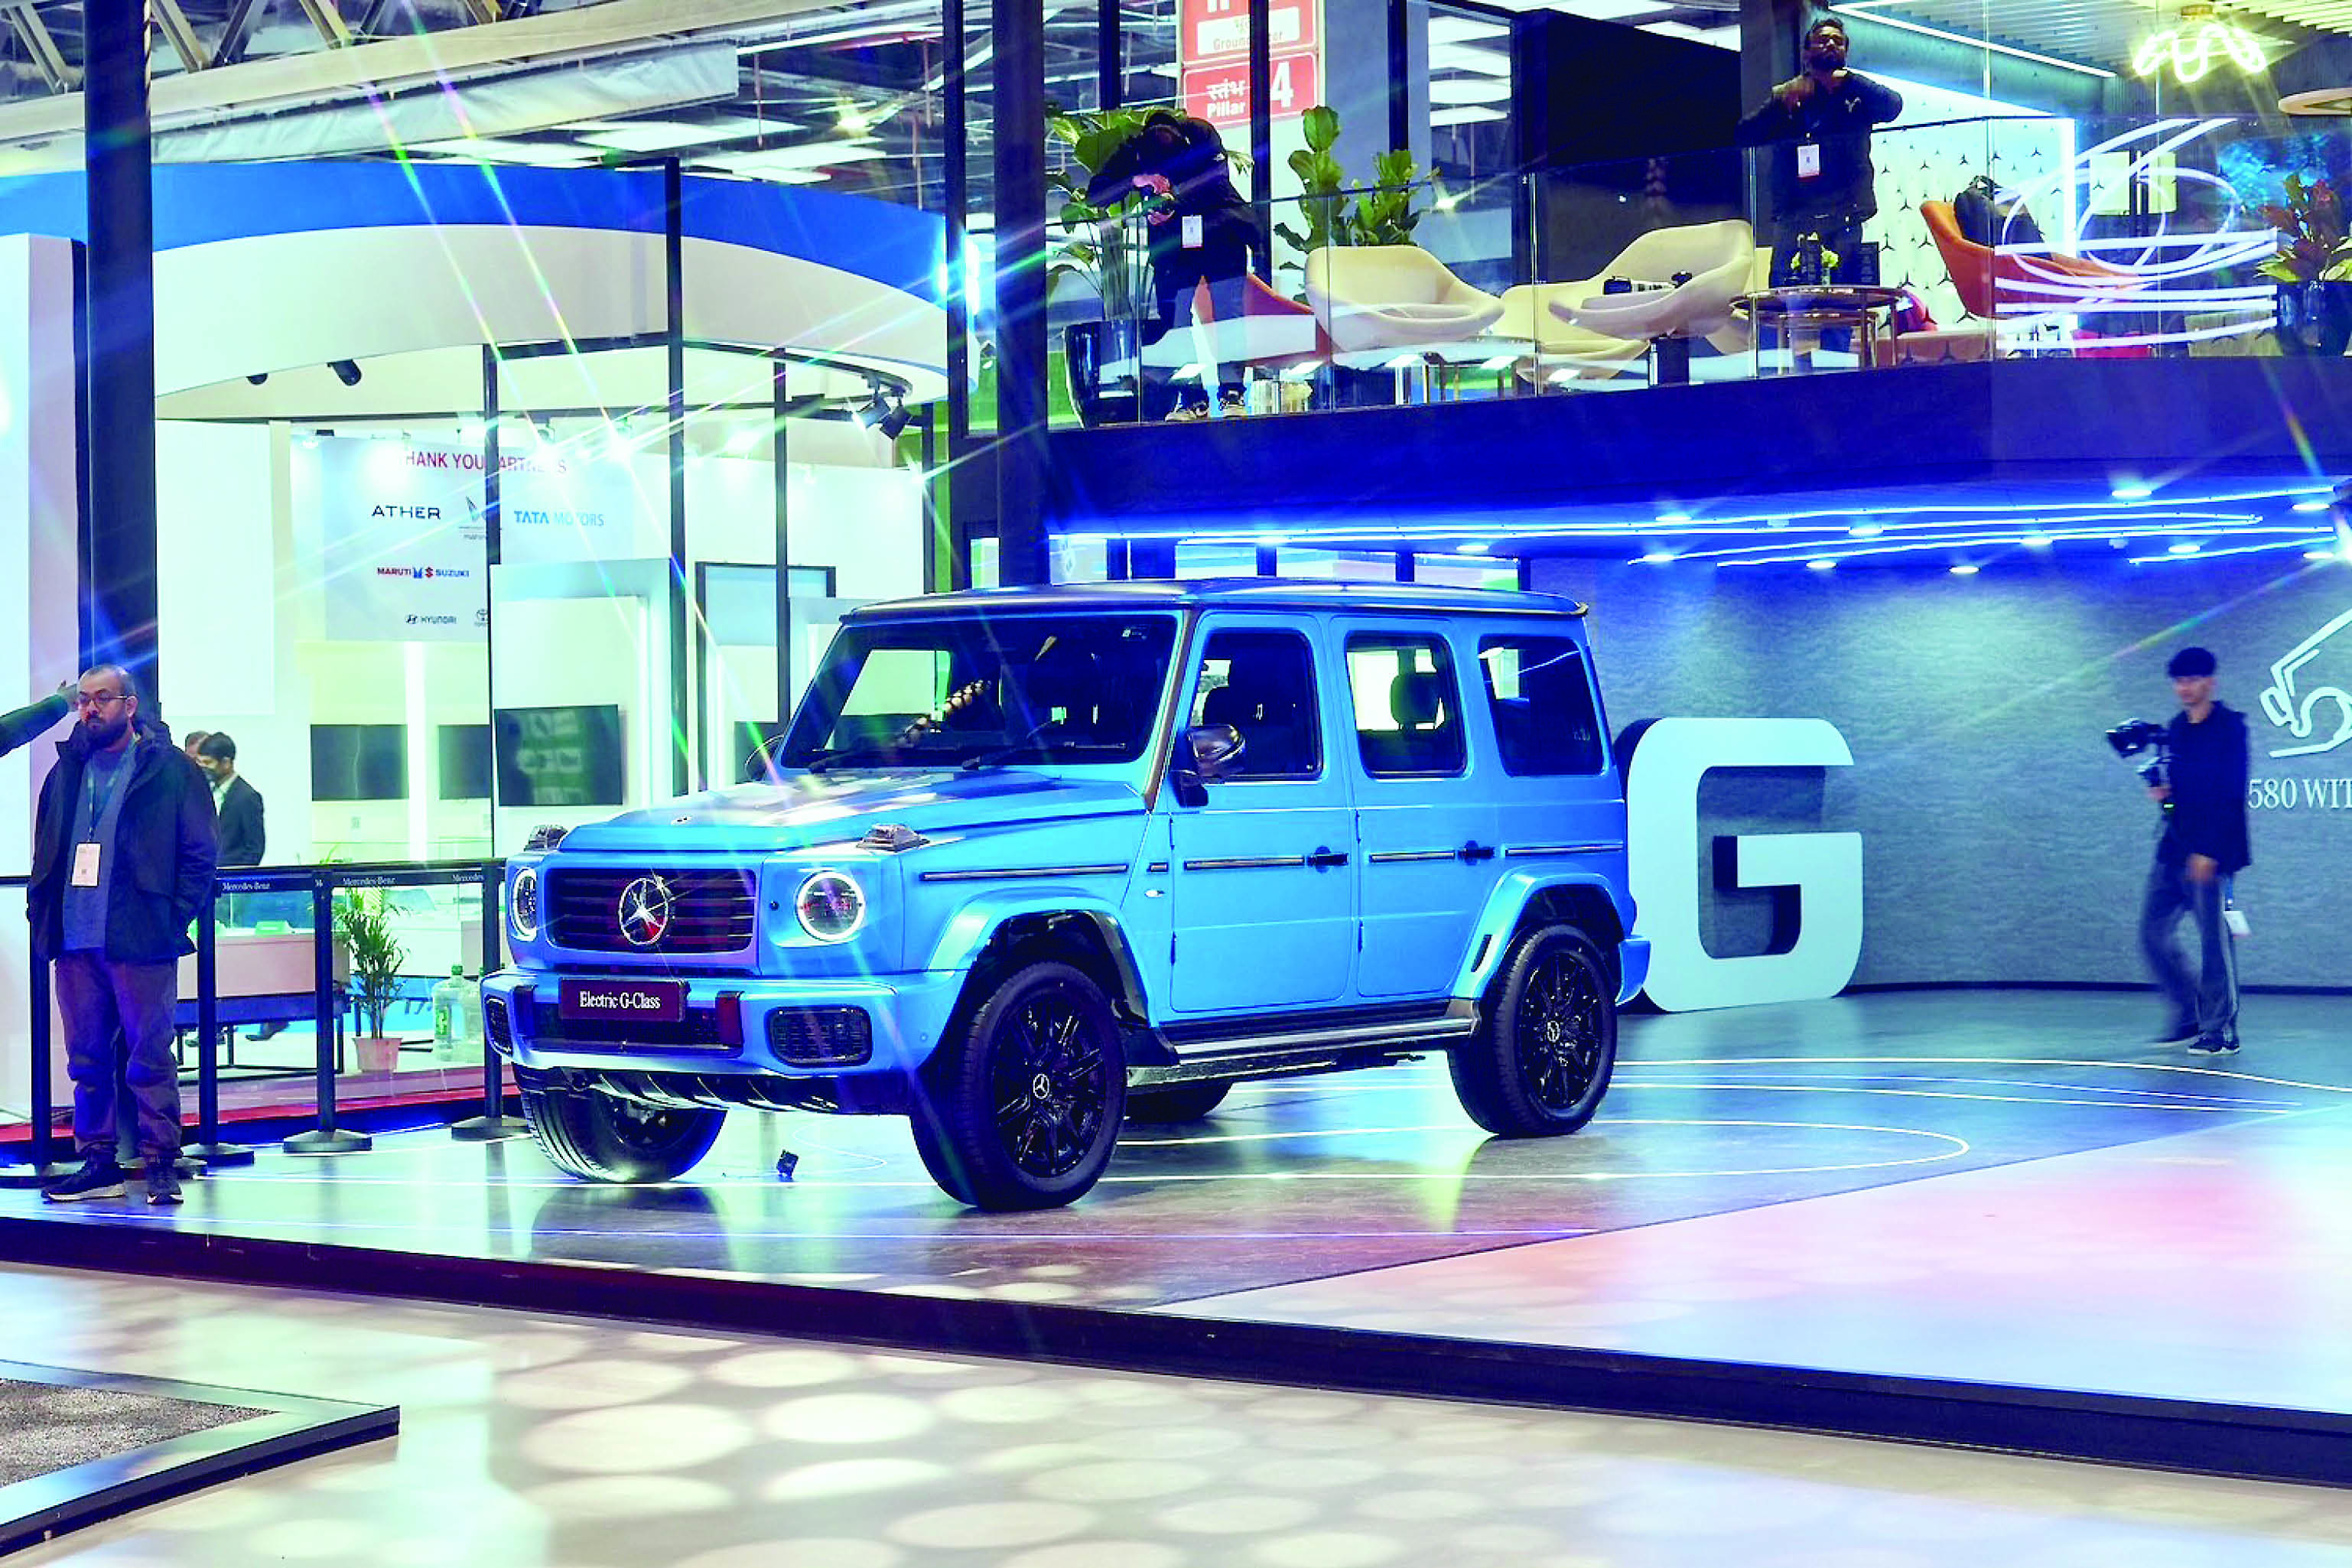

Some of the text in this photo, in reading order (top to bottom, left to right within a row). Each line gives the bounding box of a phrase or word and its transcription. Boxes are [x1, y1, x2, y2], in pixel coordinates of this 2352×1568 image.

[1207, 102, 1245, 118] Pillar
[405, 451, 448, 468] HANK
[452, 454, 485, 470] YOU
[372, 505, 441, 519] ATHER
[514, 510, 550, 524] TATA
[436, 569, 470, 577] SUZUKI
[2248, 778, 2297, 808] 580
[1628, 717, 1864, 1012] G
[580, 991, 661, 1009] Electric G-Class
